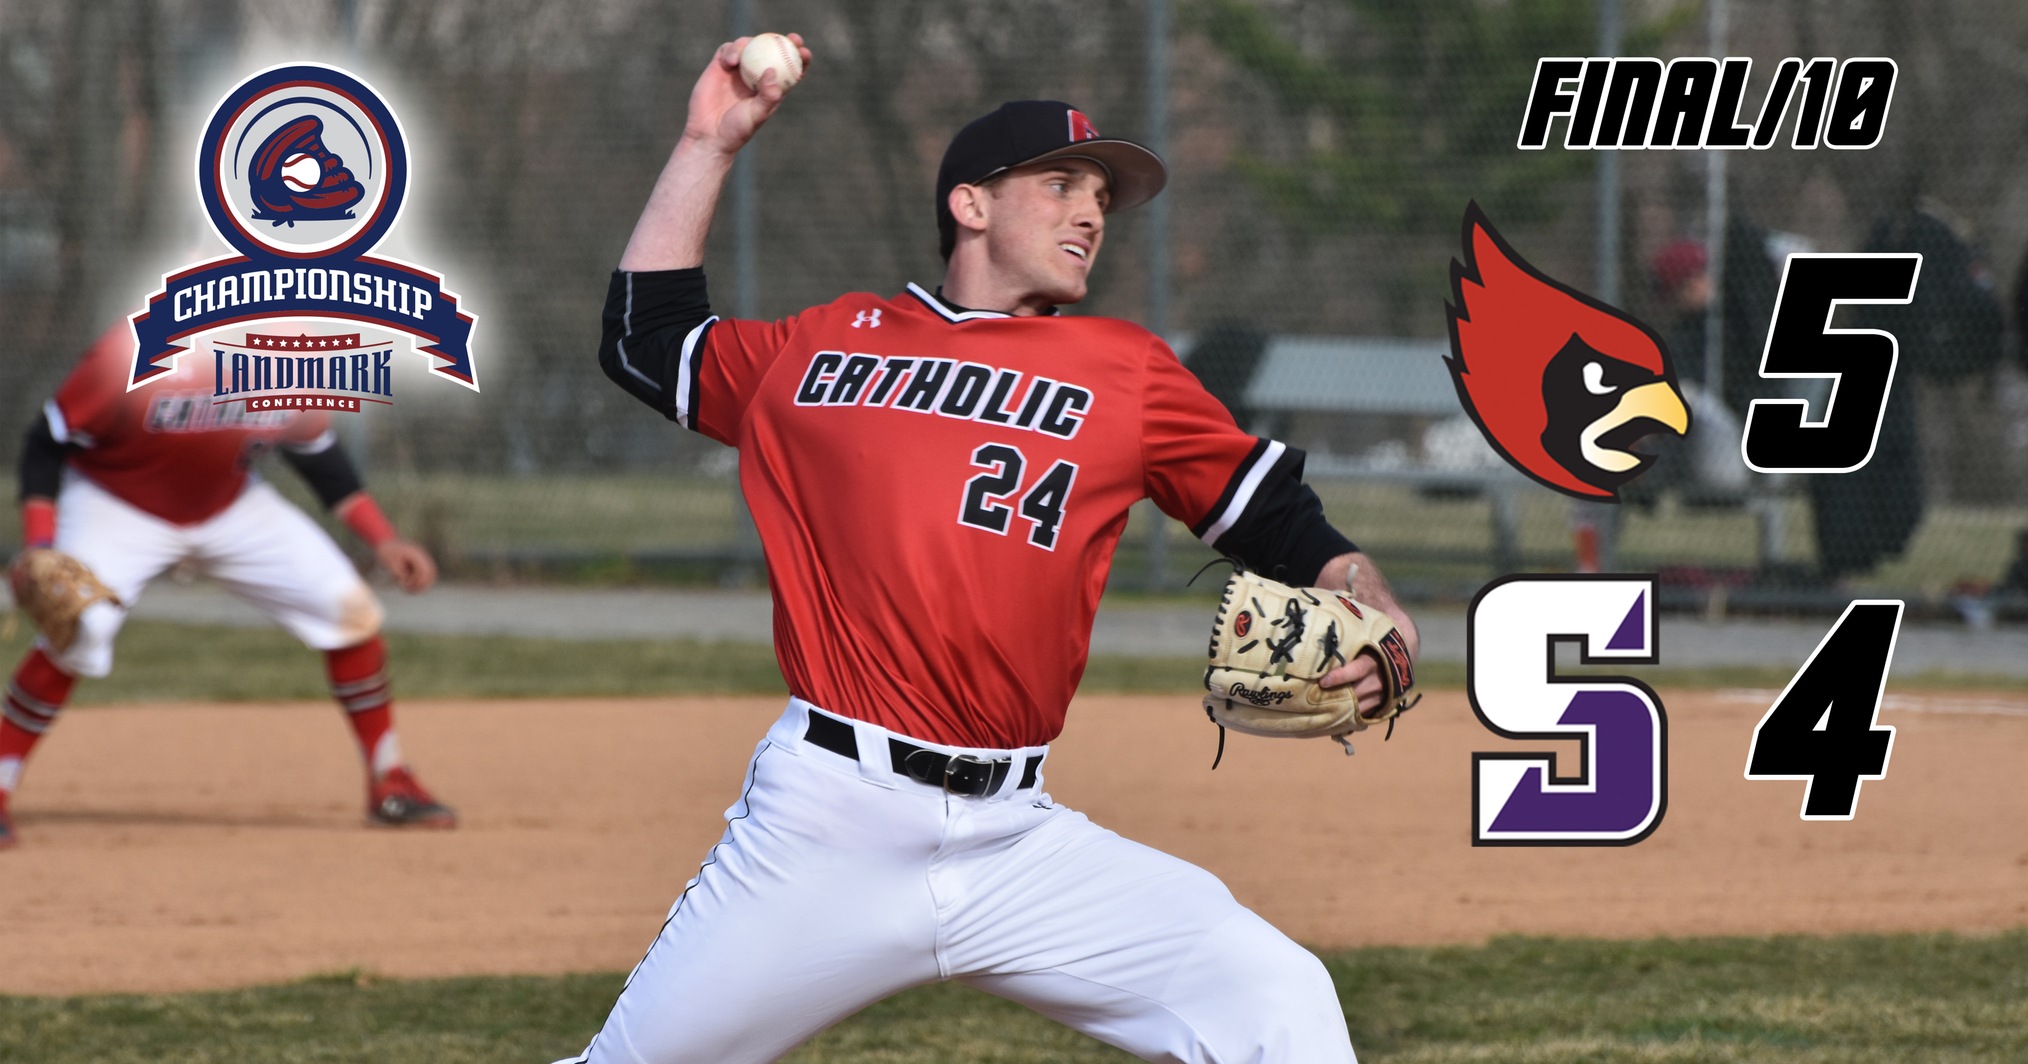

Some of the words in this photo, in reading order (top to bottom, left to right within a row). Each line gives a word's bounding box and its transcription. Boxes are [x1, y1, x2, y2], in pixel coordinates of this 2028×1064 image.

[794, 351, 1094, 440] CATHOLIC
[957, 442, 1079, 552] 24
[1229, 682, 1293, 706] Rawlings
